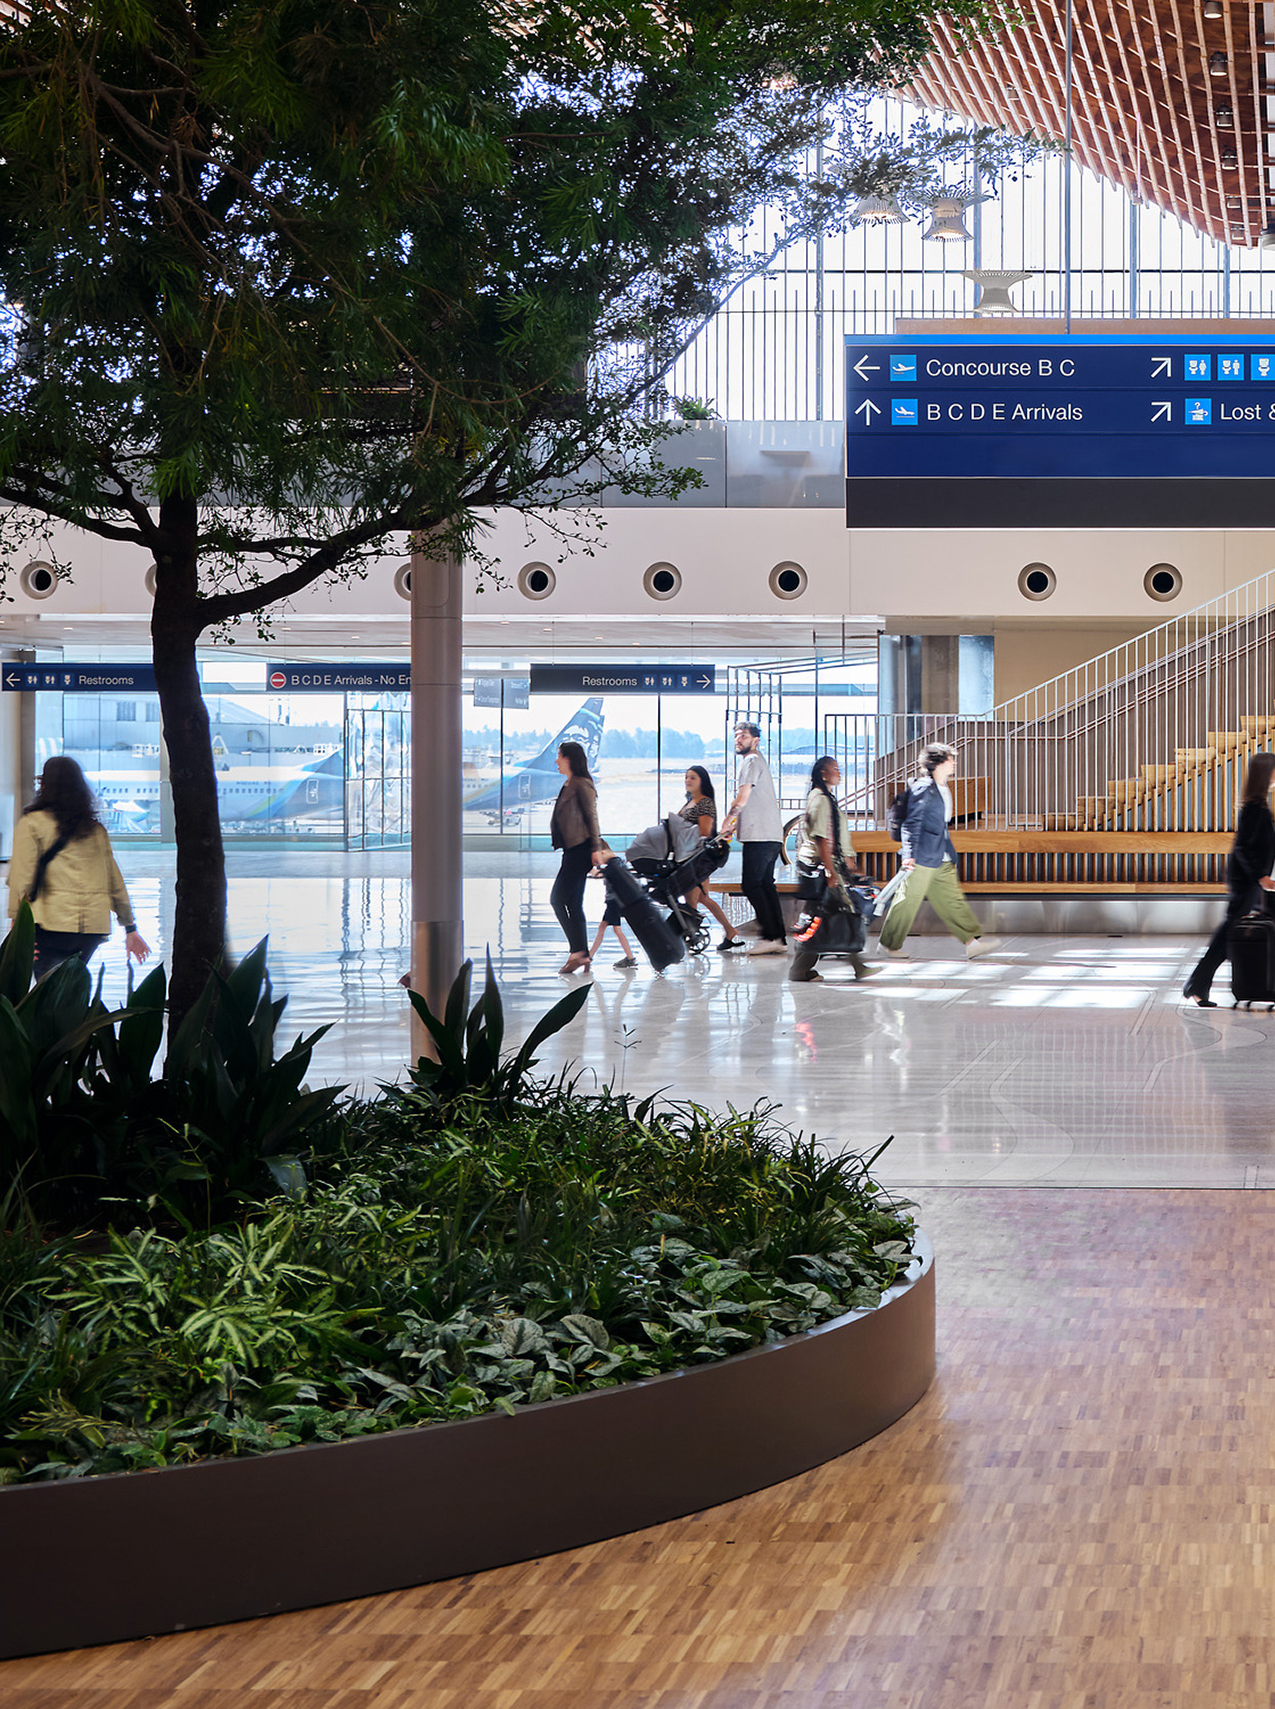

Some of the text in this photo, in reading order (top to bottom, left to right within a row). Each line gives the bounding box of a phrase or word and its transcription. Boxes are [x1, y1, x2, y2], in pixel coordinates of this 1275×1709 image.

[926, 359, 1075, 377] Concourse B C
[927, 403, 1083, 421] B C D E Arrivals
[1220, 403, 1262, 421] Lost
[79, 675, 134, 685] Restrooms
[291, 675, 300, 685] B
[301, 675, 311, 686] C
[313, 675, 322, 685] D
[323, 675, 332, 685] E
[334, 675, 373, 685] Arrivals
[380, 675, 396, 685] No
[582, 676, 638, 686] Restrooms
